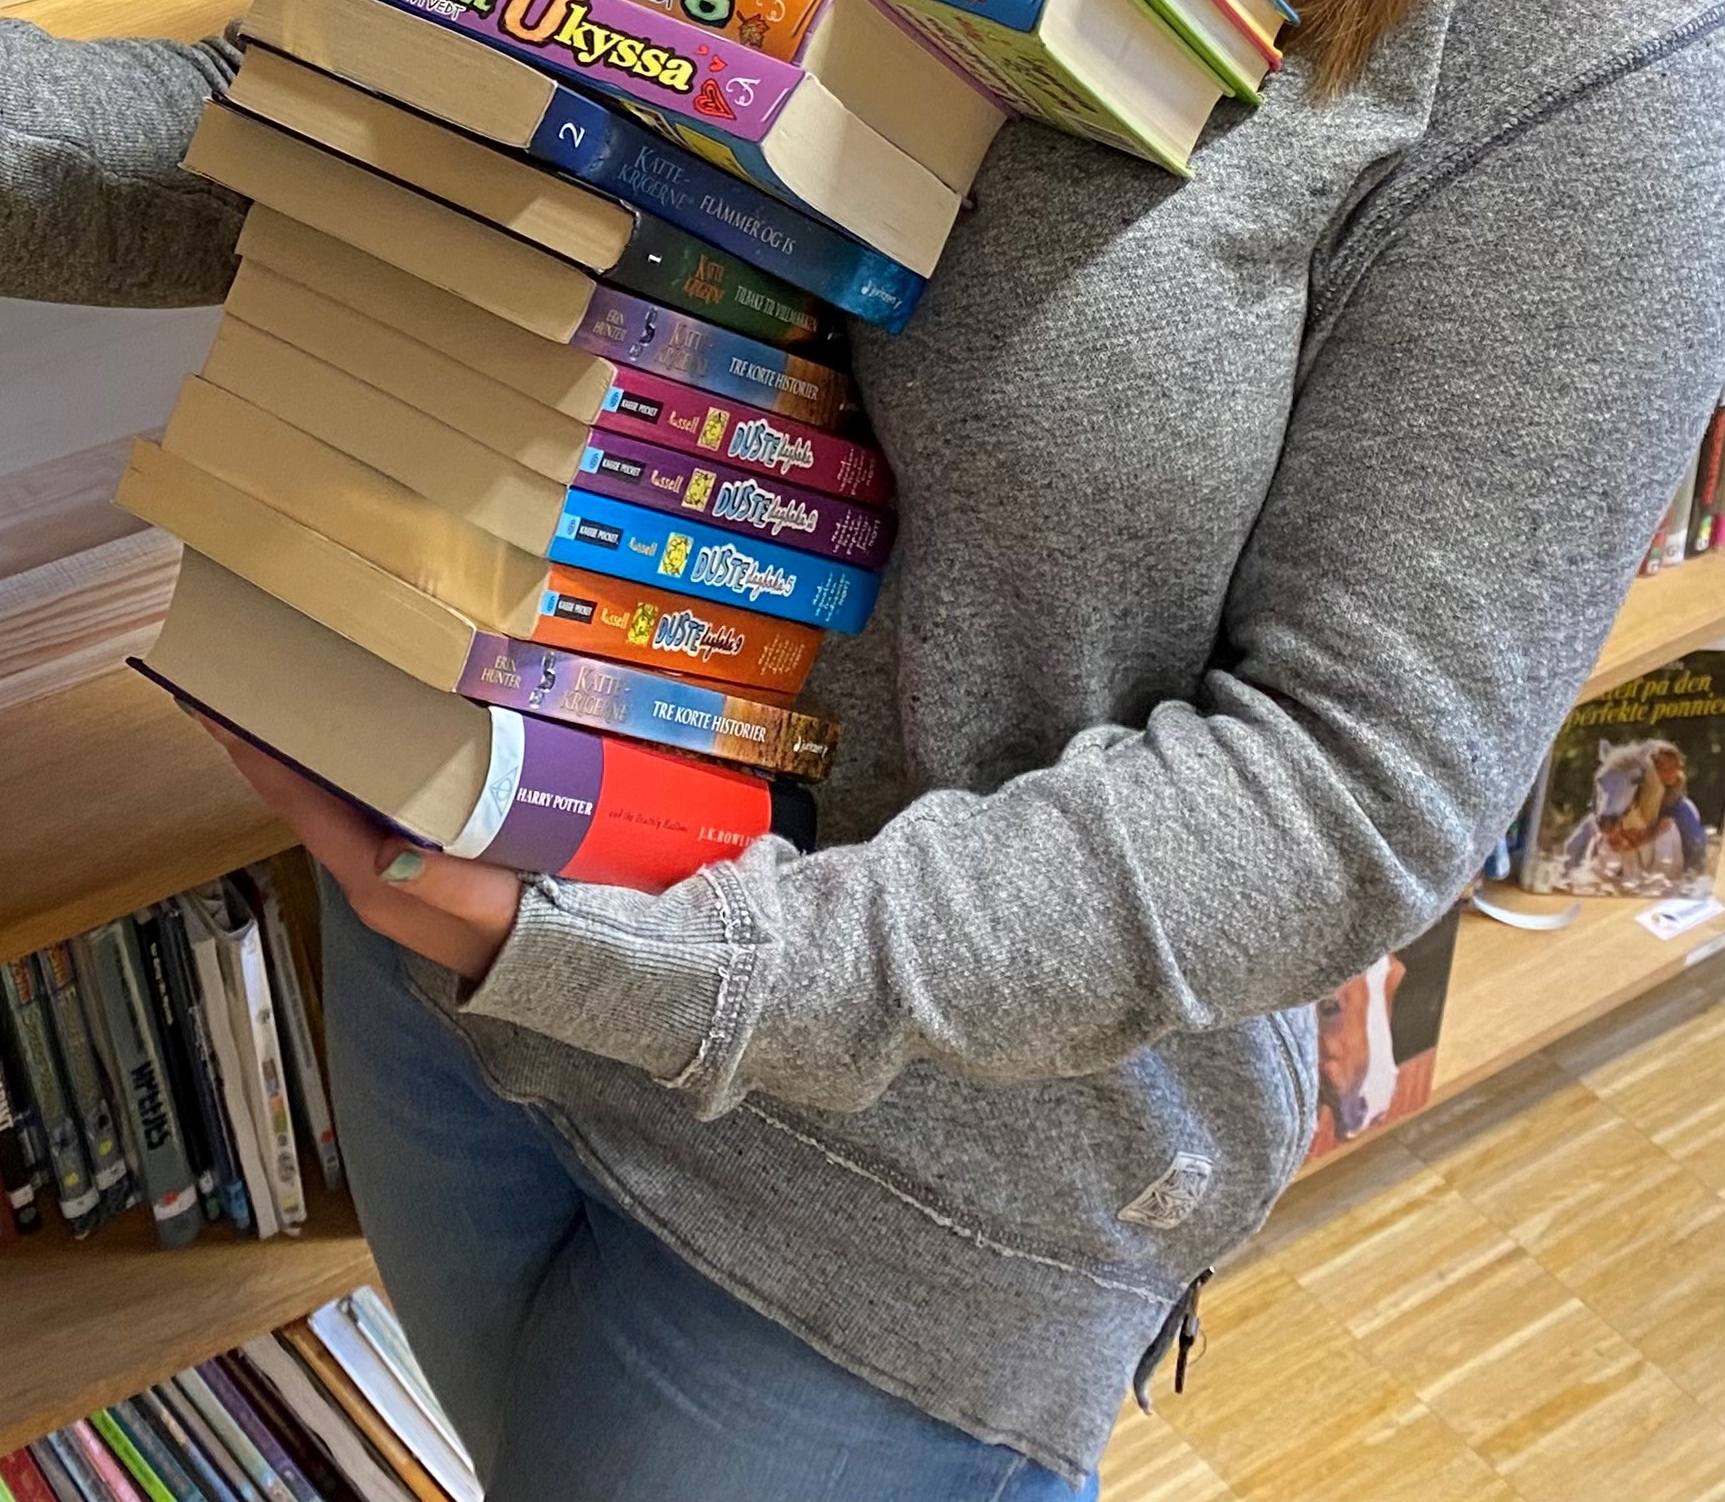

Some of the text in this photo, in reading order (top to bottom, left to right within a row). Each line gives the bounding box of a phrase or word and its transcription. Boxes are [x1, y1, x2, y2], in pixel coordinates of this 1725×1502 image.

[559, 121, 585, 148] 2
[617, 163, 688, 212] KRIGERNE
[699, 194, 796, 256] FLAMMER OG IS
[648, 253, 664, 265] 1
[729, 356, 820, 401] TRE KORTE HISTORIER
[480, 668, 522, 690] HUNTER
[494, 655, 518, 672] ERIN
[559, 690, 629, 725] KRIGERNE
[652, 700, 767, 744] TRE KORTE HISTORIER
[516, 786, 594, 817] HARRY POTTER
